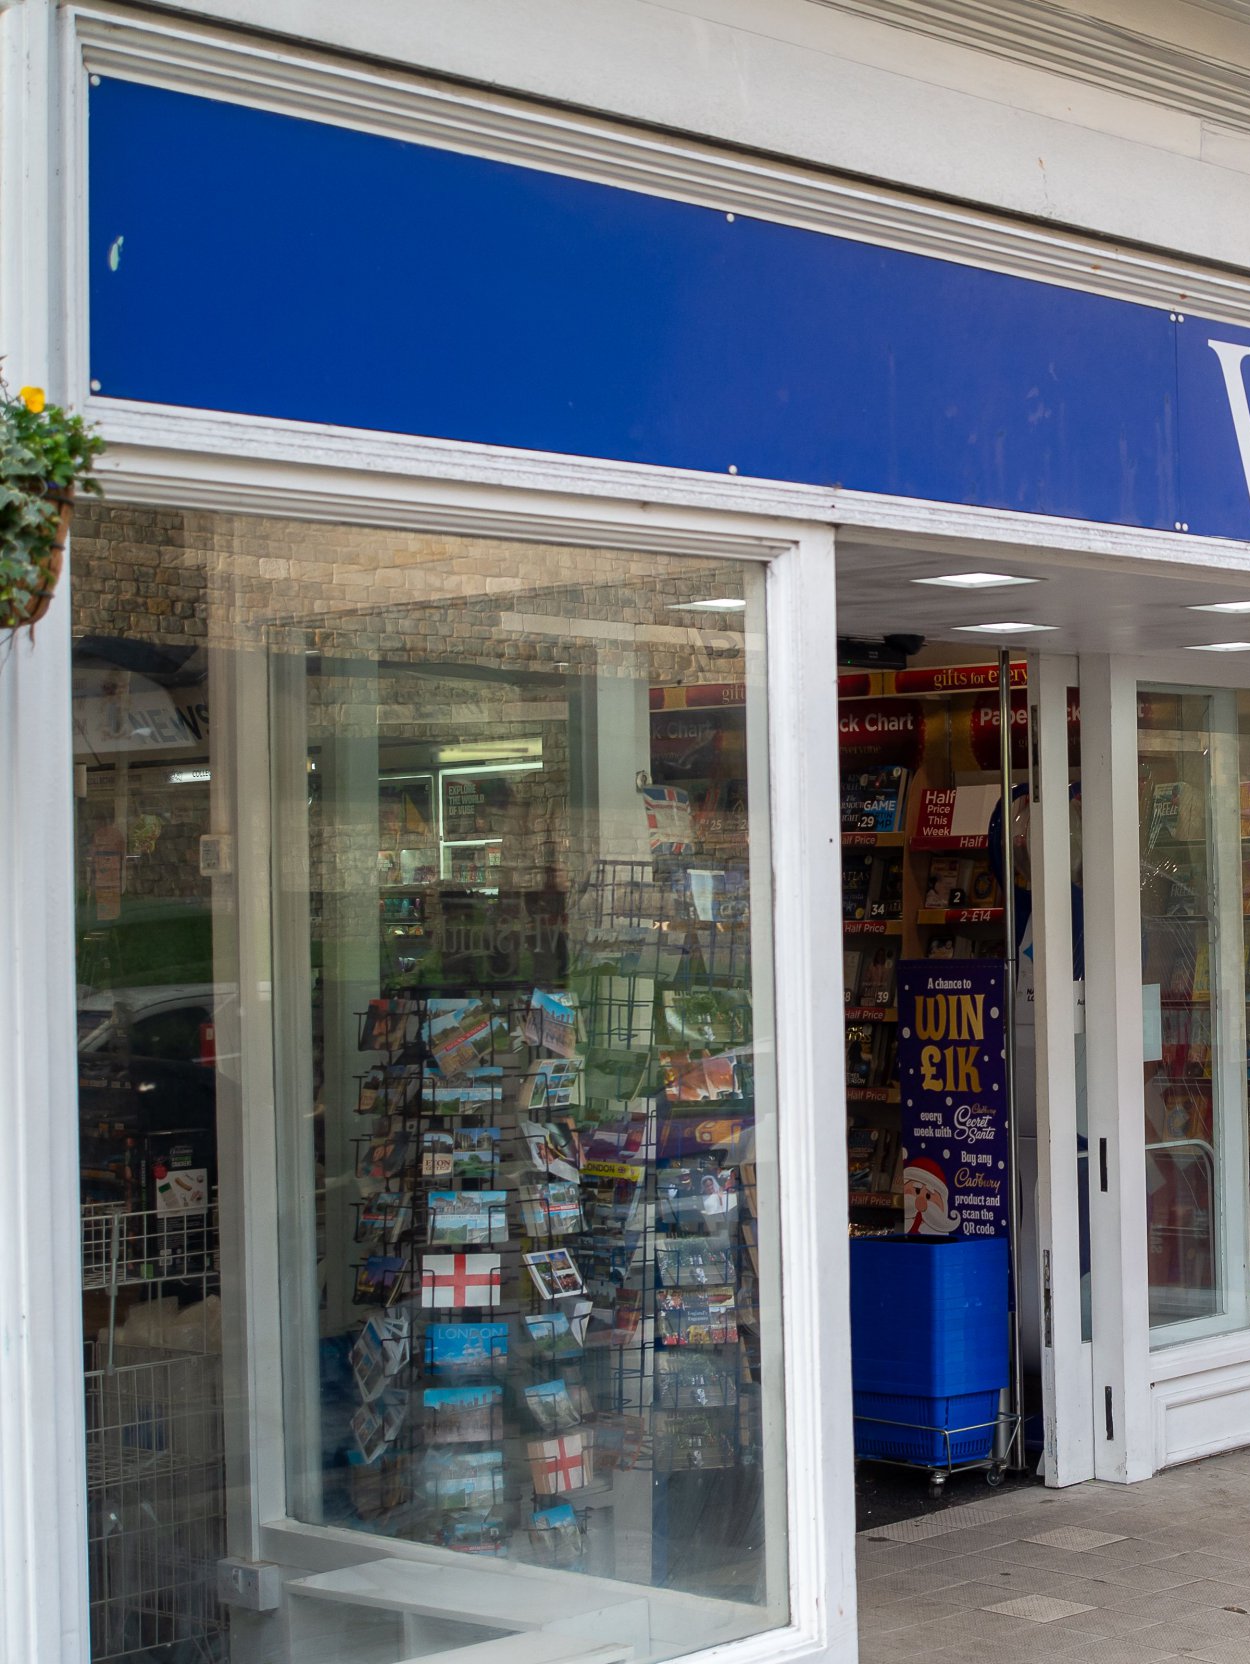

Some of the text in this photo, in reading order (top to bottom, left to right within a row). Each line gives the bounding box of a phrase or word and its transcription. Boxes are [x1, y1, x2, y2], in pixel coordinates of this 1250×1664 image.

[934, 668, 1028, 690] gifts for eery
[864, 712, 914, 732] Chart
[925, 790, 957, 804] Half
[864, 800, 896, 811] GAME
[926, 805, 951, 814] Price
[928, 816, 948, 825] This
[922, 827, 951, 836] Week
[855, 835, 876, 845] Price
[960, 836, 984, 848] Half
[871, 904, 885, 915] 34
[845, 923, 885, 934] Half Price
[927, 978, 972, 989] A chance to
[876, 991, 889, 1003] 39
[845, 1010, 884, 1020] Half Price
[914, 994, 985, 1041] WIN
[921, 1045, 982, 1093] £1K
[847, 1090, 887, 1101] Half Price
[921, 1112, 942, 1125] every
[954, 1105, 992, 1140] Secret
[914, 1126, 952, 1138] week with
[968, 1128, 996, 1144] Santa
[961, 1151, 992, 1167] Buy any
[954, 1167, 1000, 1193] Cadbury
[850, 1196, 892, 1206] Half Price
[955, 1194, 1000, 1206] product and
[962, 1209, 994, 1220] scan the
[963, 1222, 995, 1235] QR code
[438, 1328, 504, 1340] LONDON
